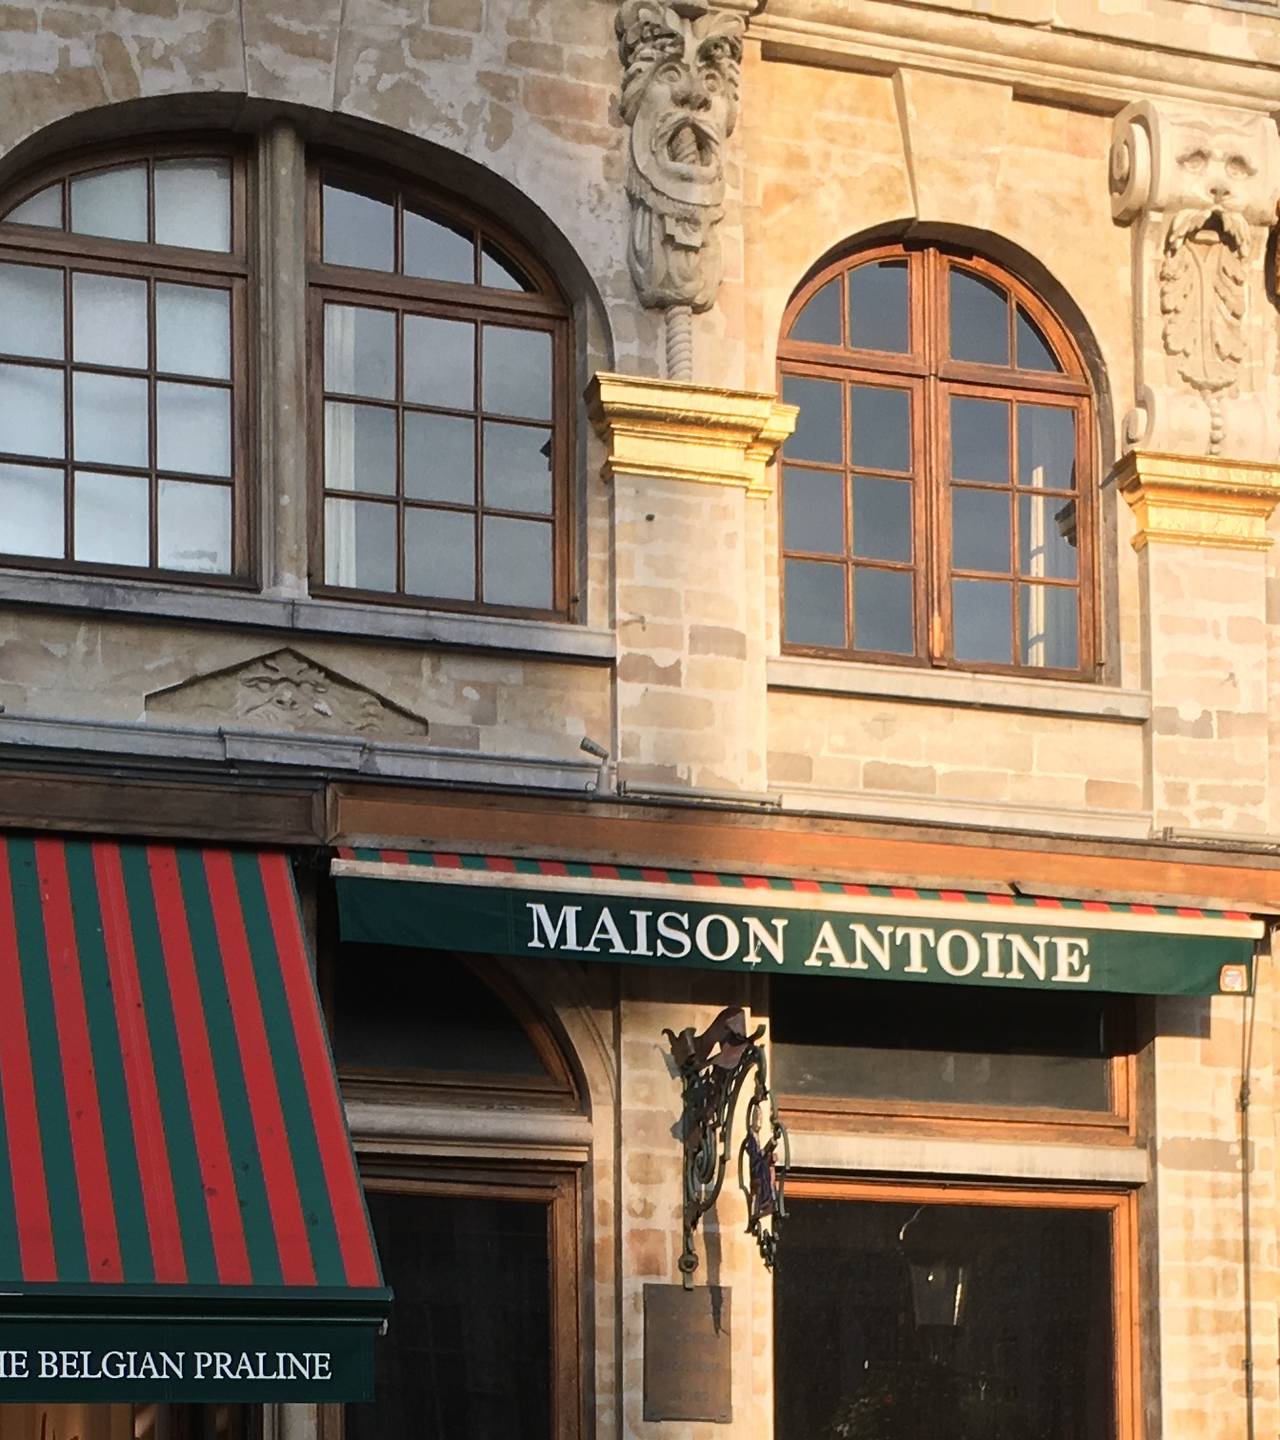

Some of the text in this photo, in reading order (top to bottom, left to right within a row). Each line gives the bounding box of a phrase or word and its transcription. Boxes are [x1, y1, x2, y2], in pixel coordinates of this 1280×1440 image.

[526, 903, 1091, 983] MAISON ANTOINE
[37, 1350, 186, 1379] BELGIAN
[193, 1351, 332, 1380] PRALINE
